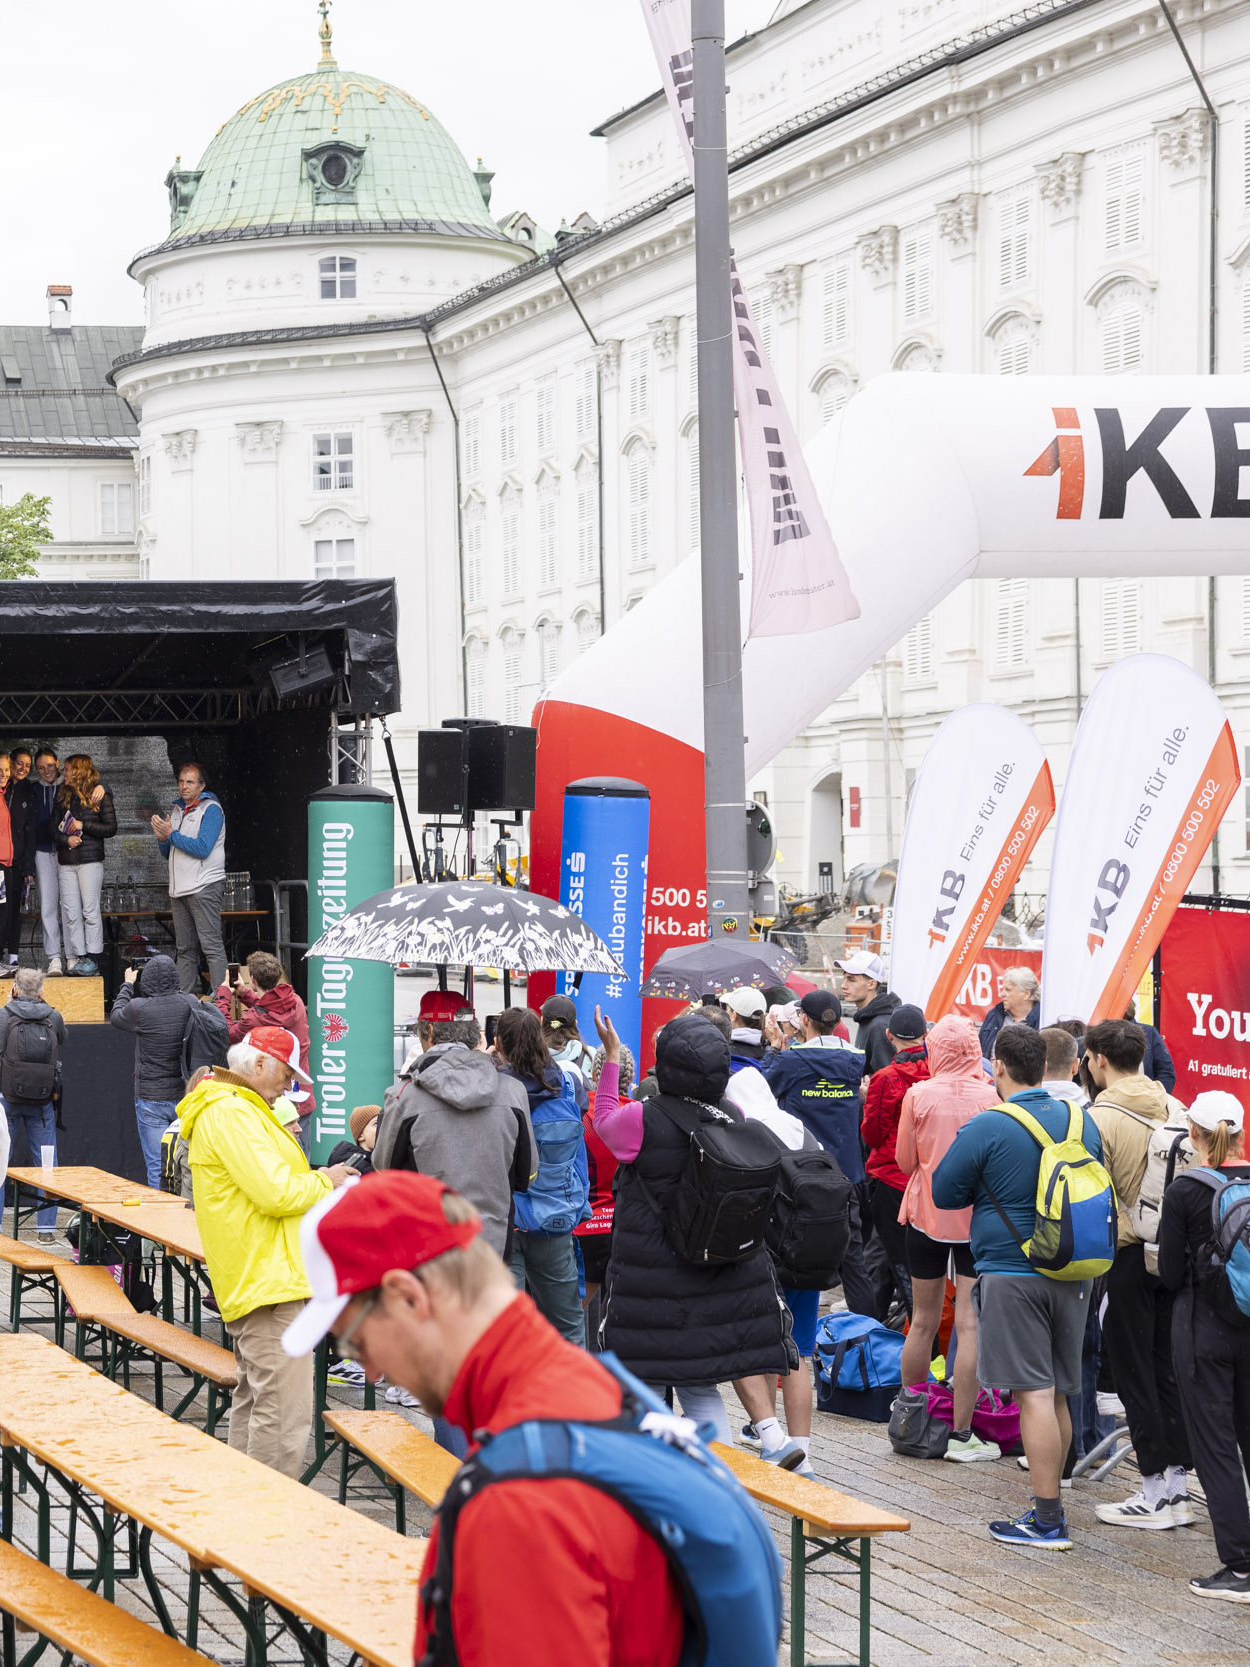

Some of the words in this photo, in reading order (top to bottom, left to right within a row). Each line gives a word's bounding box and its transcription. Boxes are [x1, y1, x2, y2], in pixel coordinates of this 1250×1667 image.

[960, 824, 984, 861] Eins
[978, 795, 997, 821] für
[993, 761, 1016, 794] alle.
[1124, 803, 1152, 849] Eins
[1144, 767, 1168, 799] für
[1162, 725, 1190, 765] alle.
[1162, 842, 1188, 882] 0800
[1181, 810, 1204, 841] 500
[1197, 779, 1220, 810] 502
[316, 822, 355, 1018] Tagzeitung
[605, 853, 630, 999] #gaubandich
[647, 916, 707, 937] ikb.at
[650, 887, 691, 907] 500
[956, 898, 992, 965] www.ikb.at
[991, 856, 1012, 889] 0800
[1008, 830, 1025, 856] 500
[1021, 805, 1040, 831] 502
[955, 963, 993, 1006] KB
[316, 1043, 347, 1143] Tiroler
[801, 1089, 822, 1097] new
[1187, 1059, 1199, 1073] A1
[1201, 1062, 1248, 1080] gratuliert
